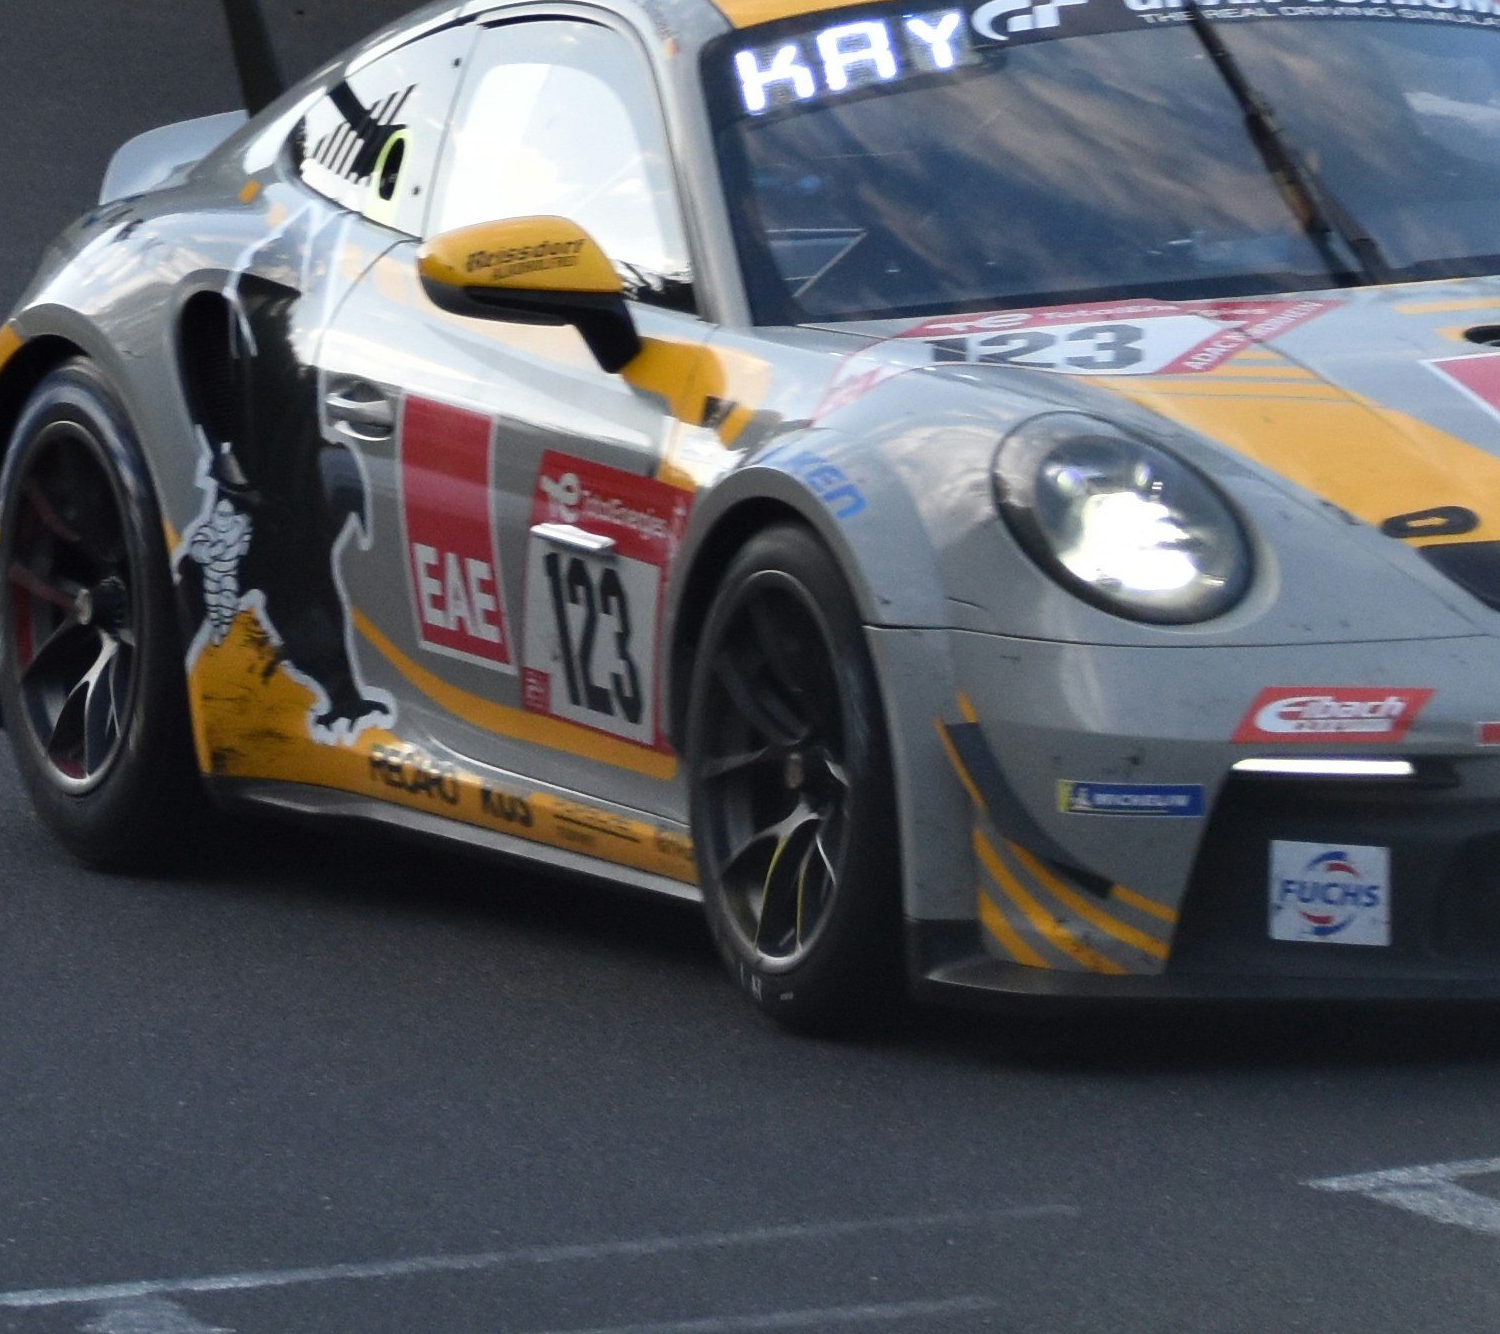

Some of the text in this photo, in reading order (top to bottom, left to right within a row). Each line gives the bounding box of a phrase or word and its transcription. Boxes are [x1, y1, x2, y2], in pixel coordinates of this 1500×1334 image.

[1202, 6, 1279, 19] REAL
[1280, 5, 1397, 19] DRIVING
[924, 323, 1145, 370] 123
[413, 541, 501, 645] EAE
[543, 550, 644, 726] 123
[1281, 878, 1381, 907] FUCHS
